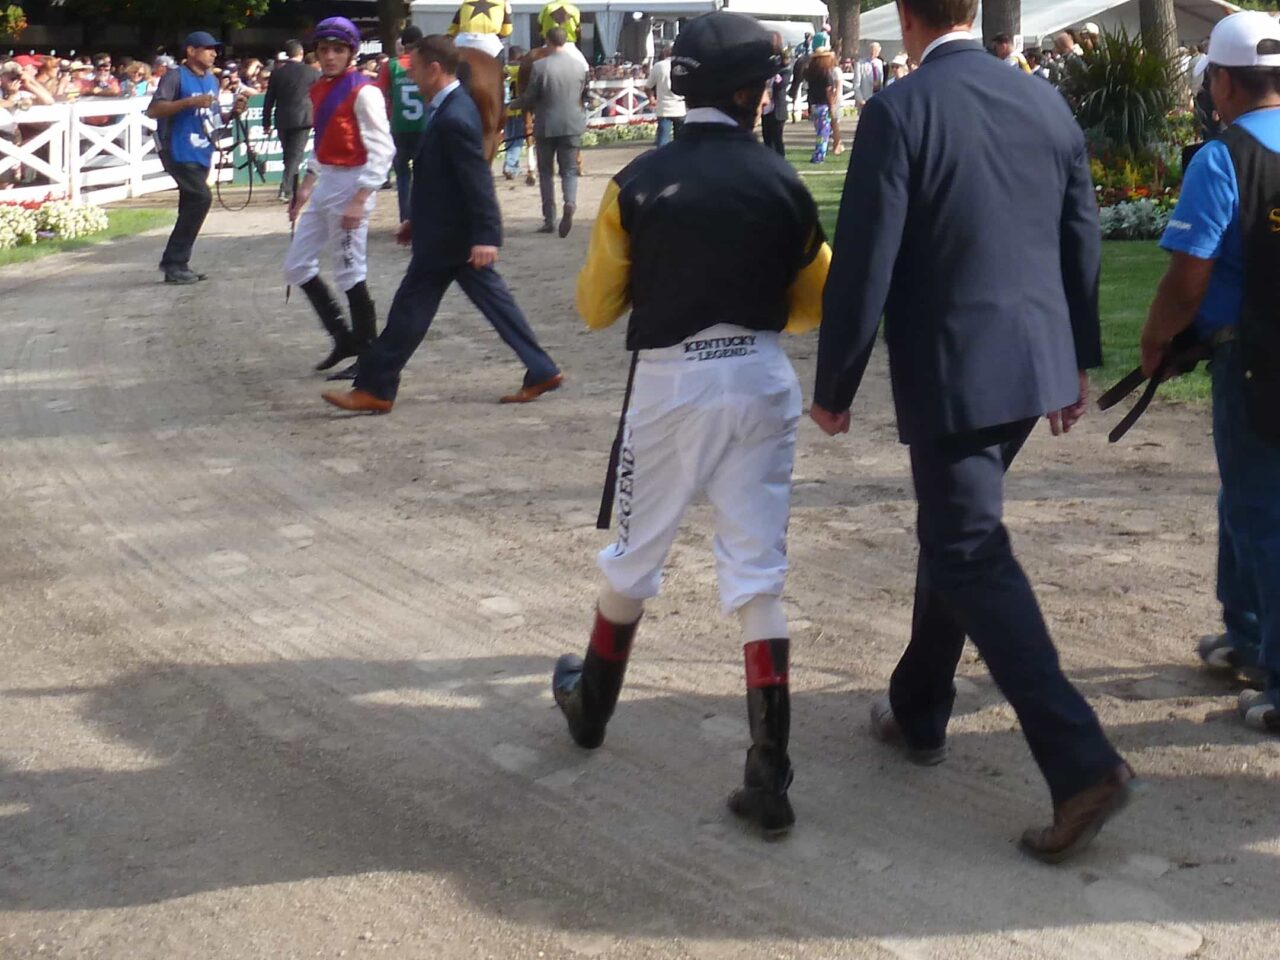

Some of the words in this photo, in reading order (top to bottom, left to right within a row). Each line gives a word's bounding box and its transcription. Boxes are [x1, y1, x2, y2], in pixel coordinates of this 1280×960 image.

[401, 84, 423, 120] 5
[684, 335, 756, 353] KENTUCKY
[698, 347, 747, 361] LEGEND
